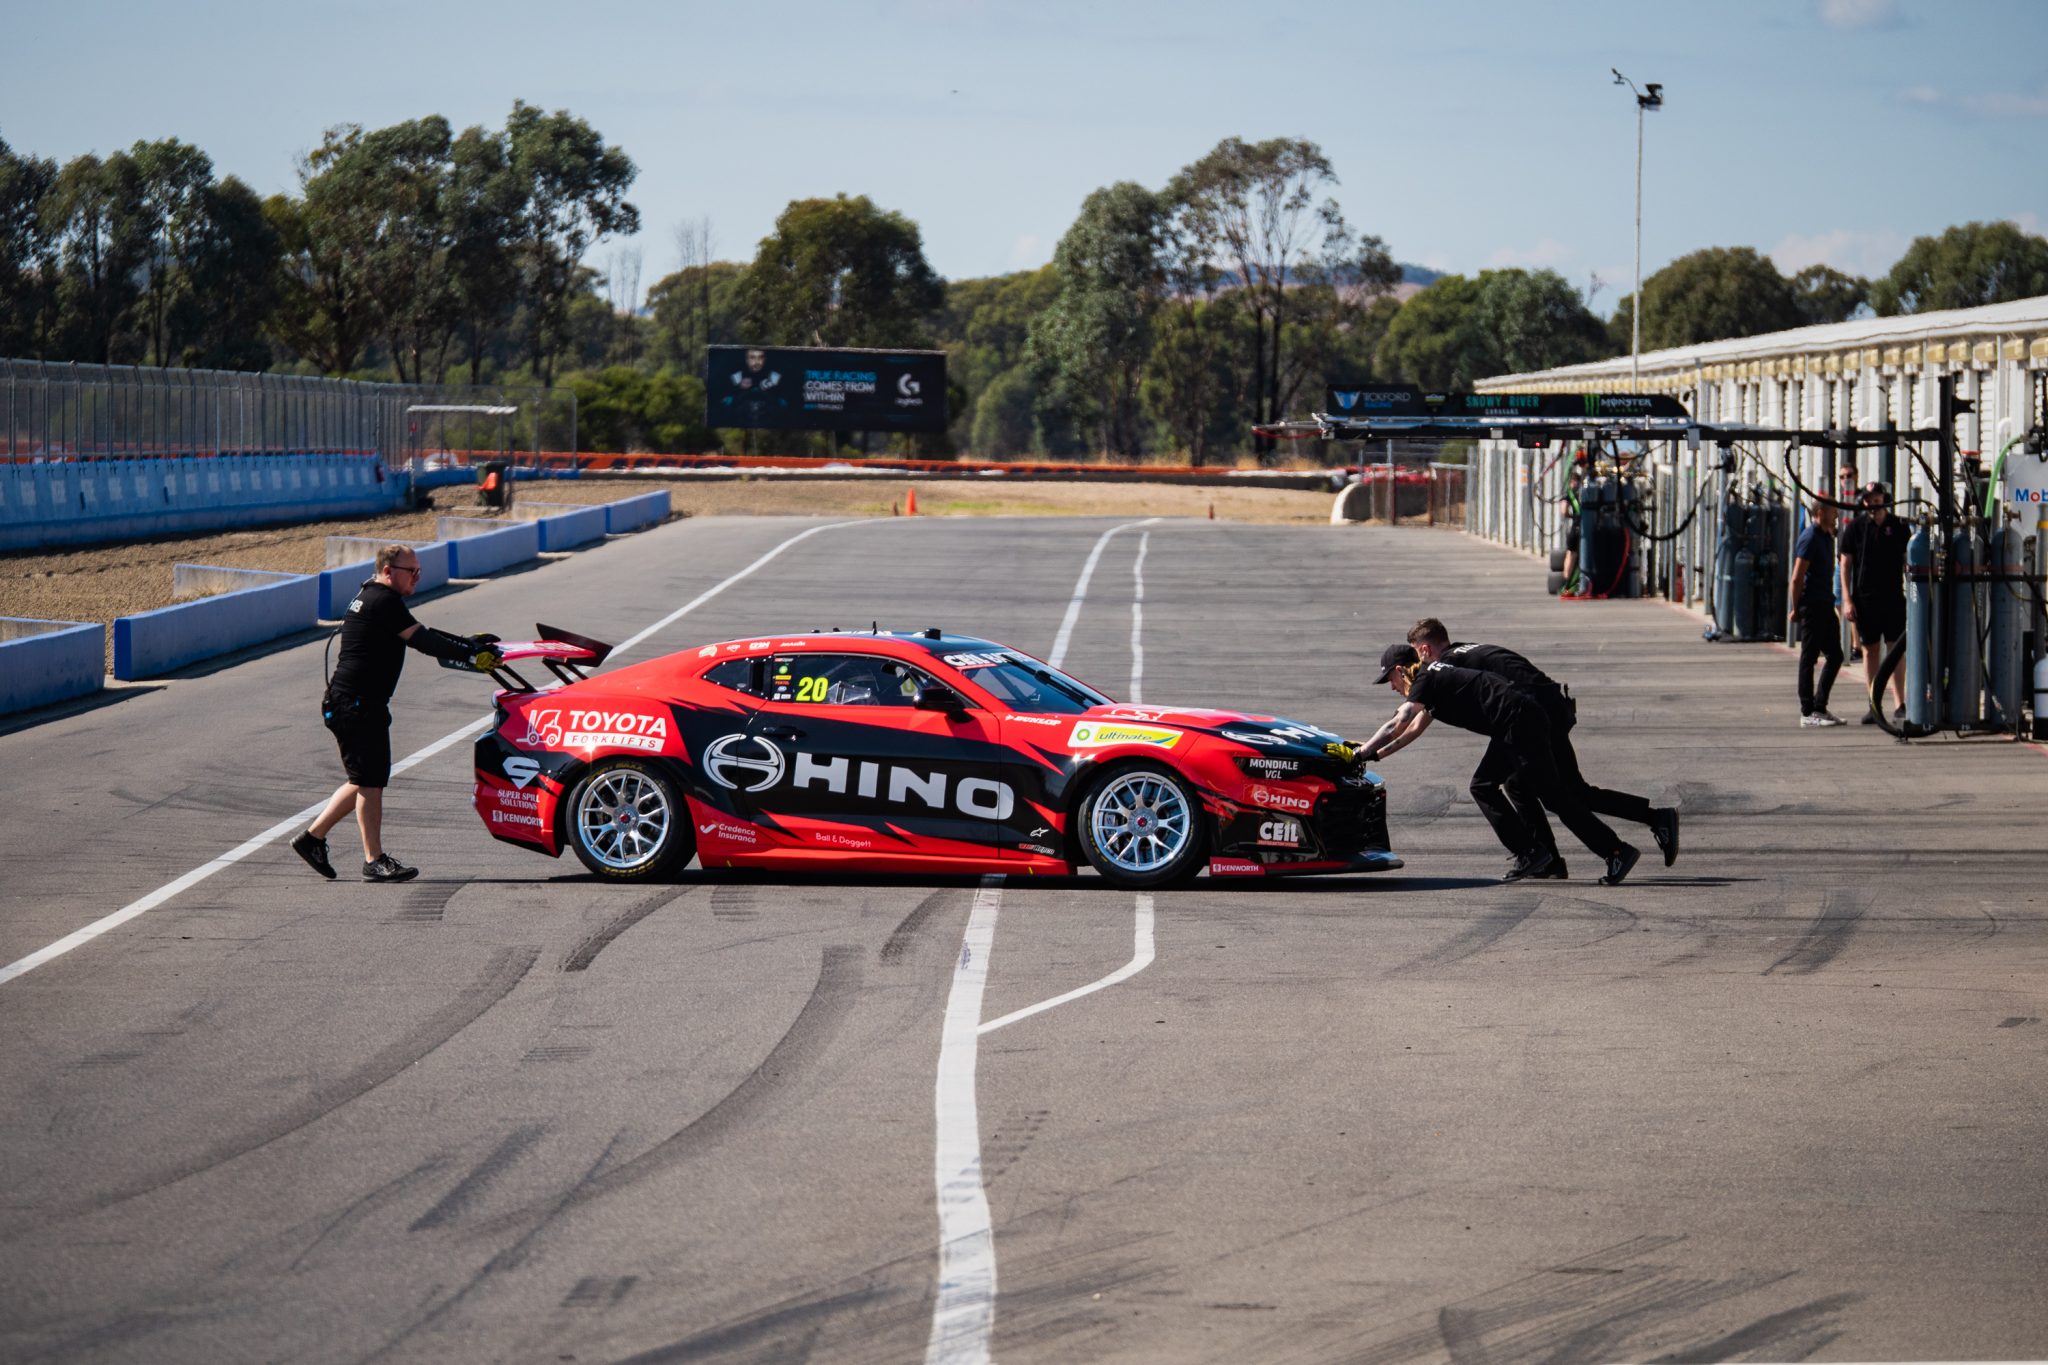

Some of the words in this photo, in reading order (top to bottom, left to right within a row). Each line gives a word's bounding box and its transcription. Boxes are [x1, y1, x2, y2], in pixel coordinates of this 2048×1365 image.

[834, 371, 877, 381] RACING
[805, 381, 843, 391] COMES
[845, 382, 876, 393] FROM
[805, 392, 845, 402] WITHIN
[1465, 395, 1502, 408] SNOWY
[1508, 395, 1540, 408] RIVER
[1600, 398, 1653, 408] MONSTER
[795, 676, 829, 702] 20
[569, 710, 667, 737] TOYOTA
[1013, 715, 1062, 726] DUNLOP
[571, 735, 656, 748] FORKLIFTS
[1099, 731, 1153, 741] ultimate
[1250, 758, 1299, 771] MONDIALE
[1265, 770, 1282, 779] VGL
[793, 753, 1015, 820] HINO
[497, 789, 521, 799] SUPER
[522, 792, 540, 802] SPILL
[1269, 794, 1310, 809] HINO
[500, 798, 538, 810] SOLUTIONS
[503, 812, 544, 828] KENWORTH
[718, 823, 756, 836] Credence
[1260, 821, 1299, 842] CEIL
[718, 830, 757, 844] Insurance
[815, 832, 831, 842] Ball
[838, 836, 872, 848] Doggett
[1221, 864, 1259, 872] KENWORTH
